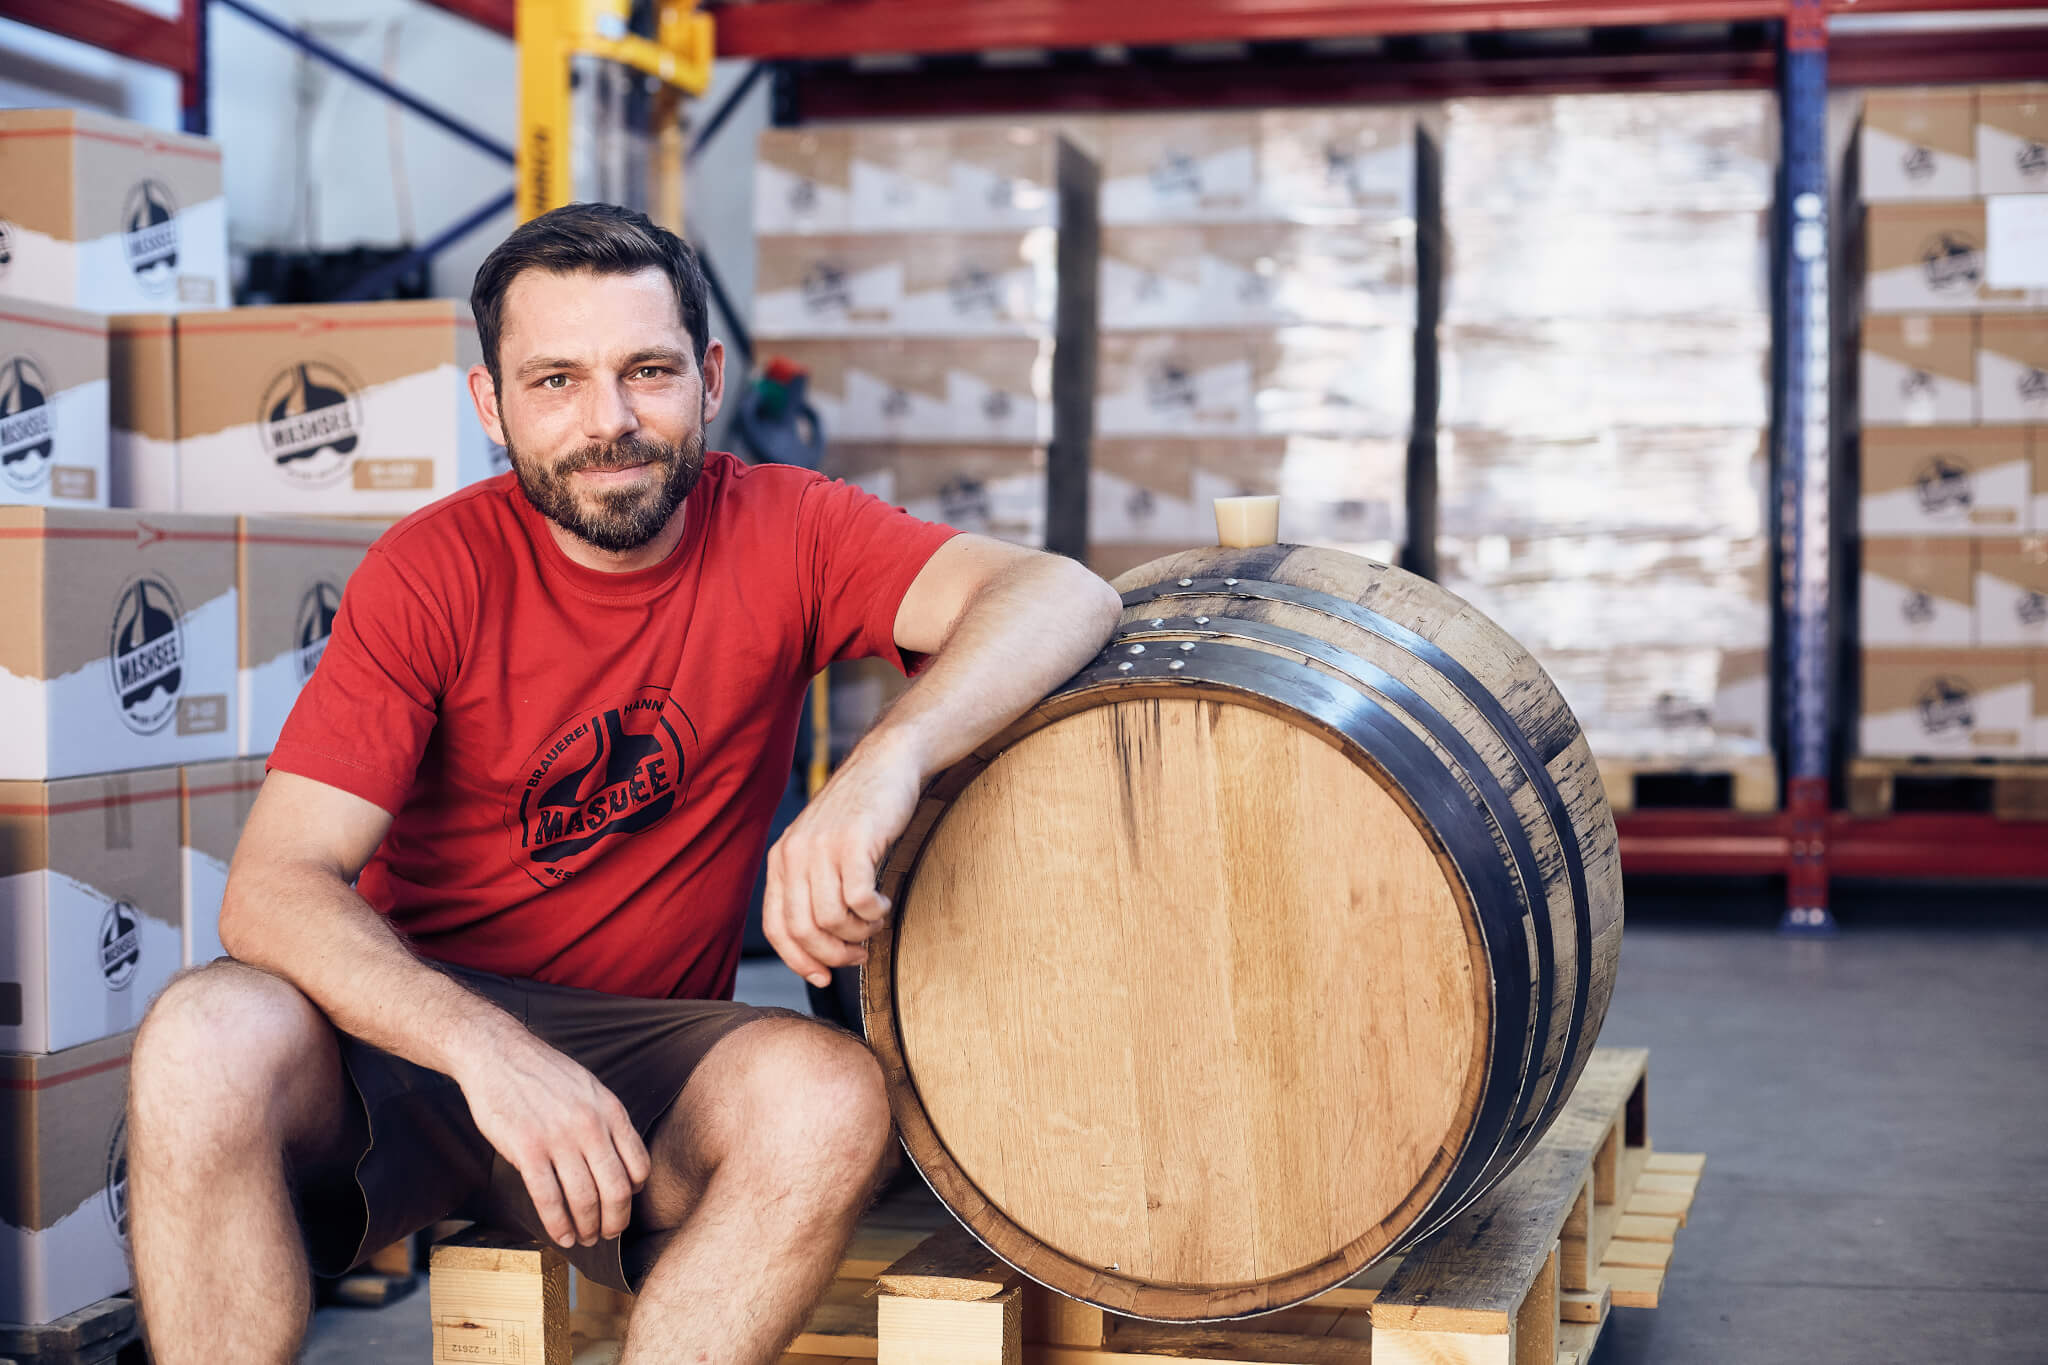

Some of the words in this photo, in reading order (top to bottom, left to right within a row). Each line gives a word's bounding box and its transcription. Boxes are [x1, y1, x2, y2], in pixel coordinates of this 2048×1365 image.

[119, 636, 179, 690] MASHSEE
[526, 722, 589, 789] BRAUEREI
[623, 698, 665, 716] HANN
[485, 1330, 497, 1339] HT
